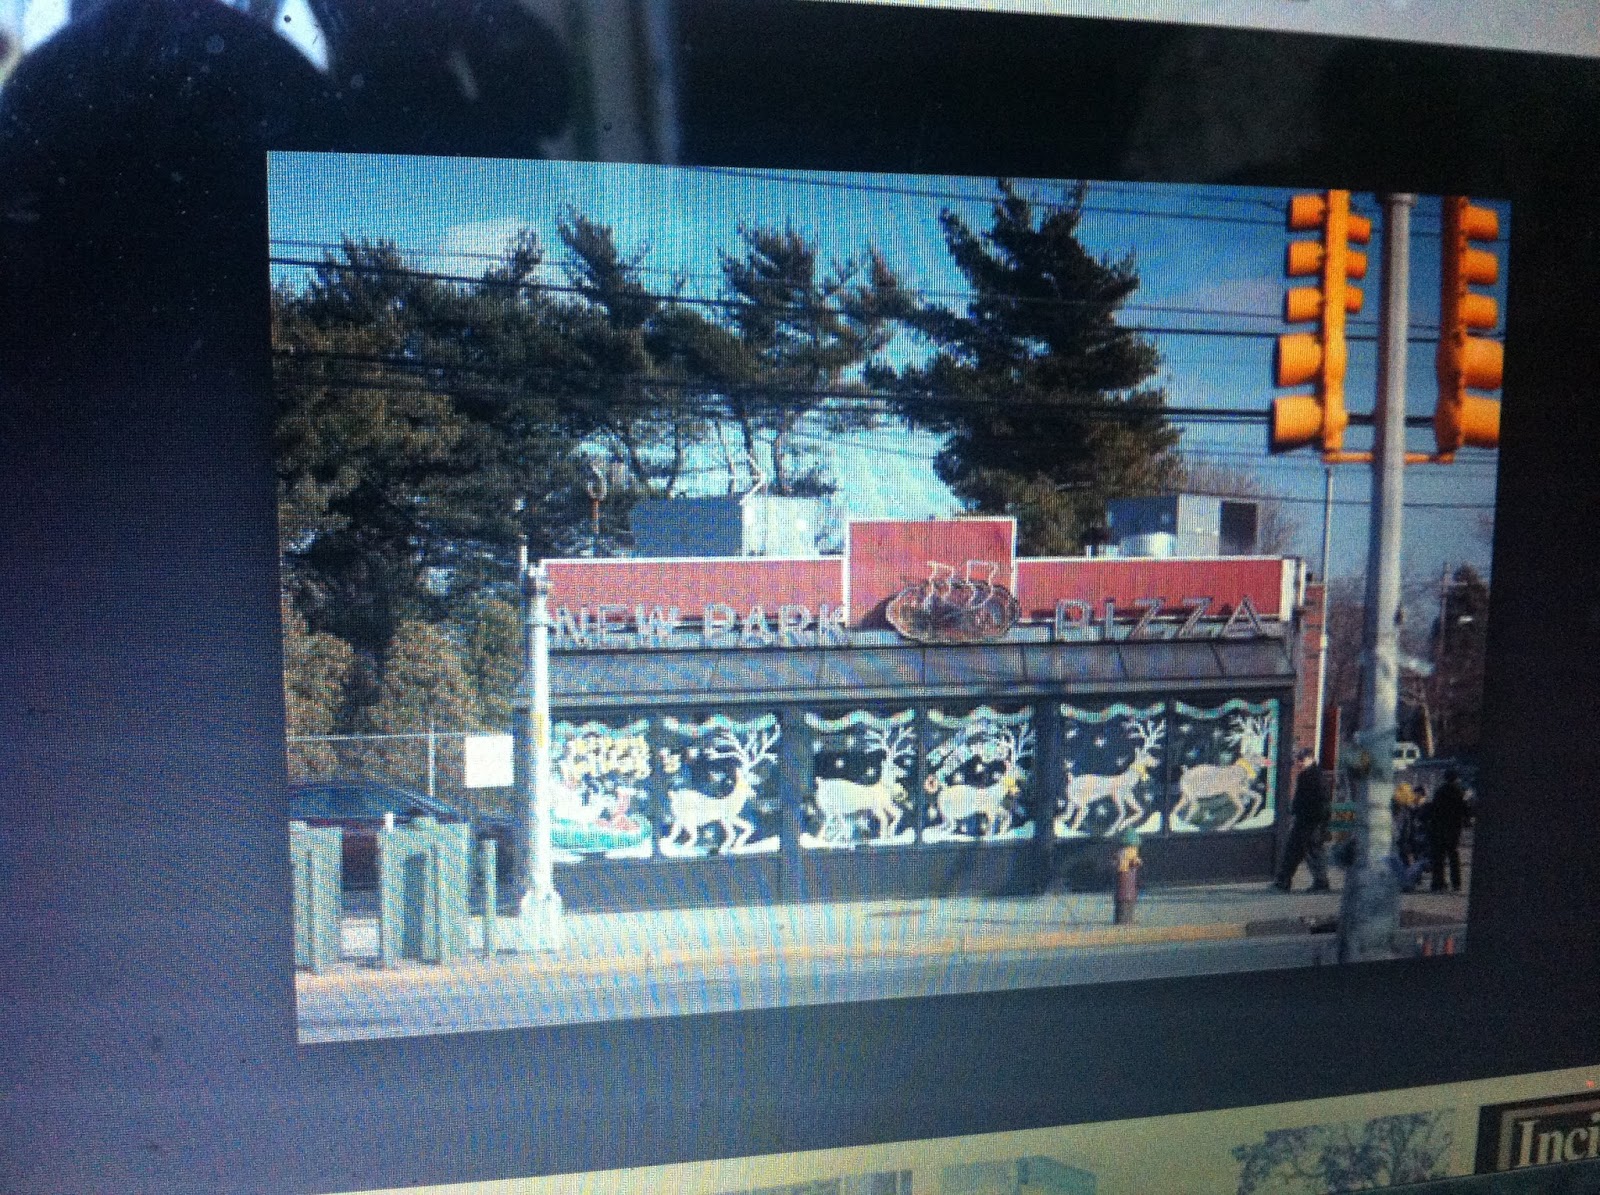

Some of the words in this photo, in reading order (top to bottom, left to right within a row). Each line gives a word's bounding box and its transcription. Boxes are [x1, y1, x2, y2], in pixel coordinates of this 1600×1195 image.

[555, 603, 680, 648] NEW
[704, 603, 848, 647] PARK
[1054, 596, 1263, 642] PIZZA
